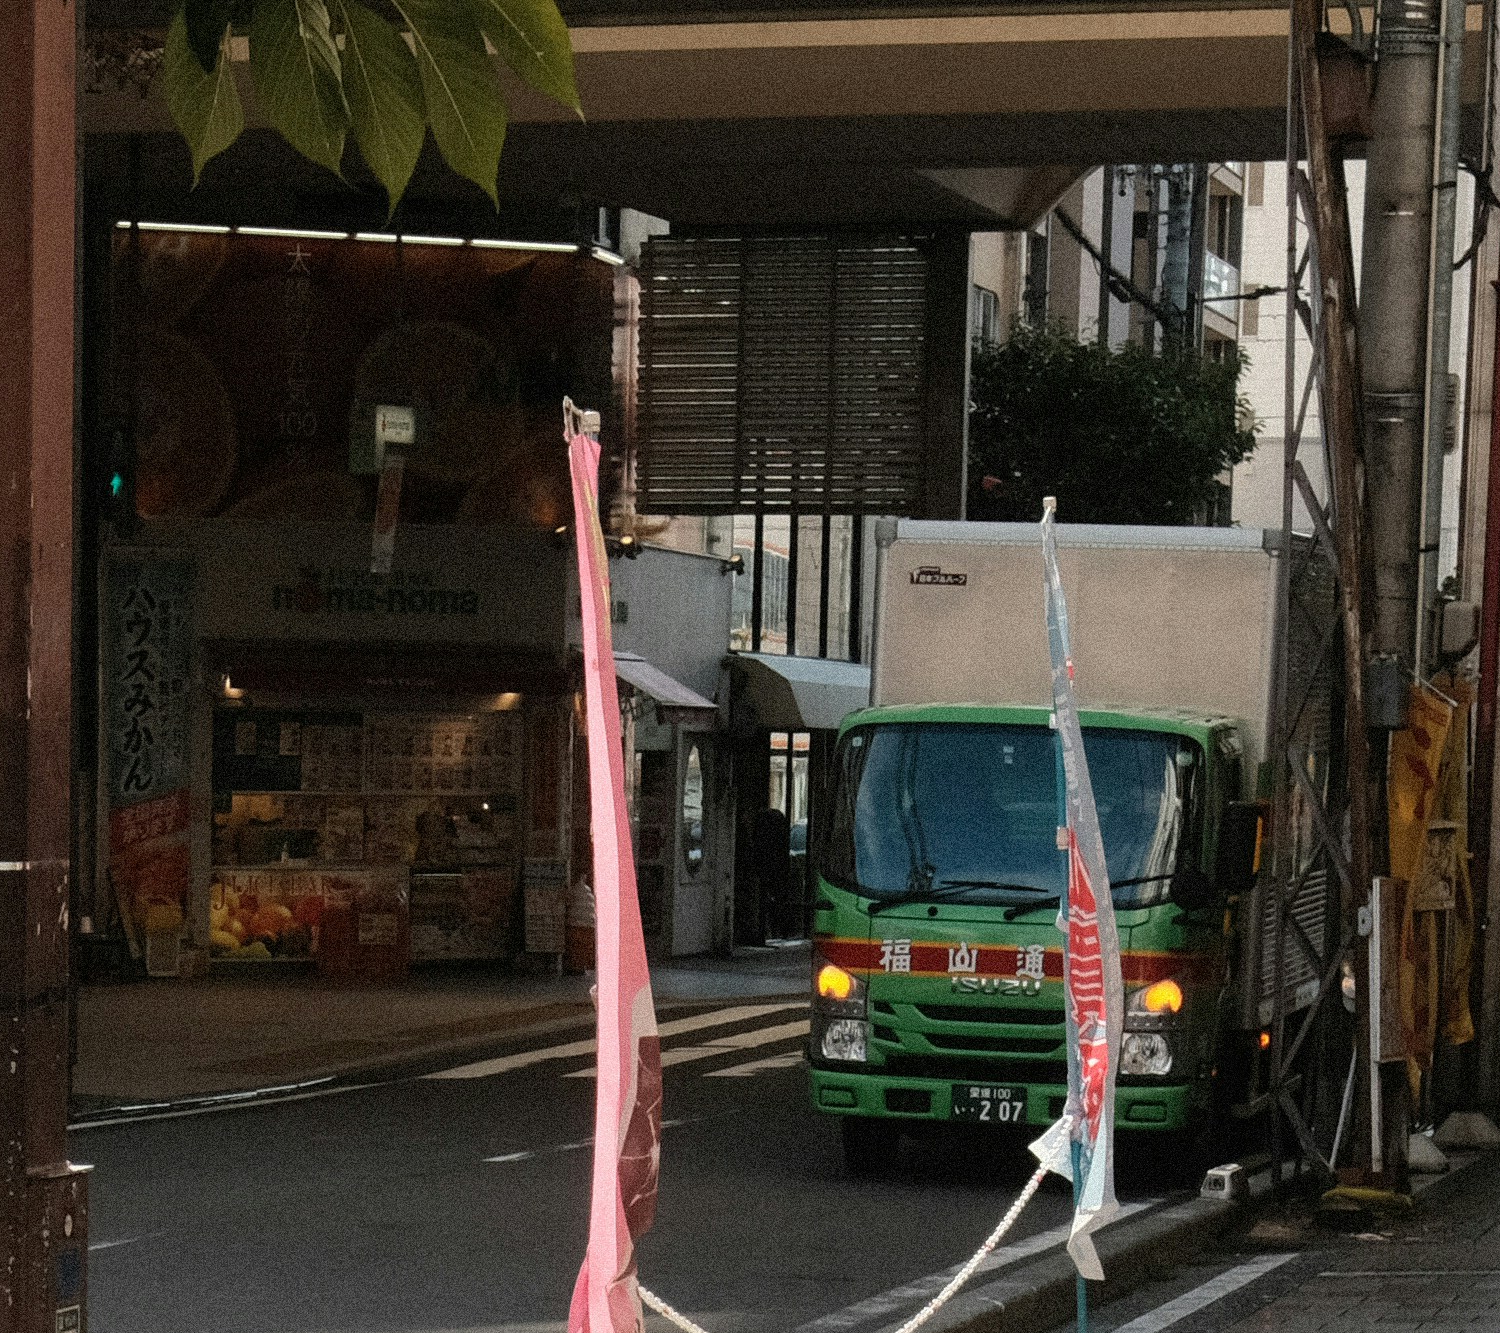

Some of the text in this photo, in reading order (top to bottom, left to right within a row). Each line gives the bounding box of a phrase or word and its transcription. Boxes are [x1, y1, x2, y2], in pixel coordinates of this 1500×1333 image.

[123, 587, 157, 793] ハウスみかん
[879, 938, 1046, 979] 福山通
[950, 975, 1042, 996] ISUZU
[993, 1087, 1012, 1099] 100
